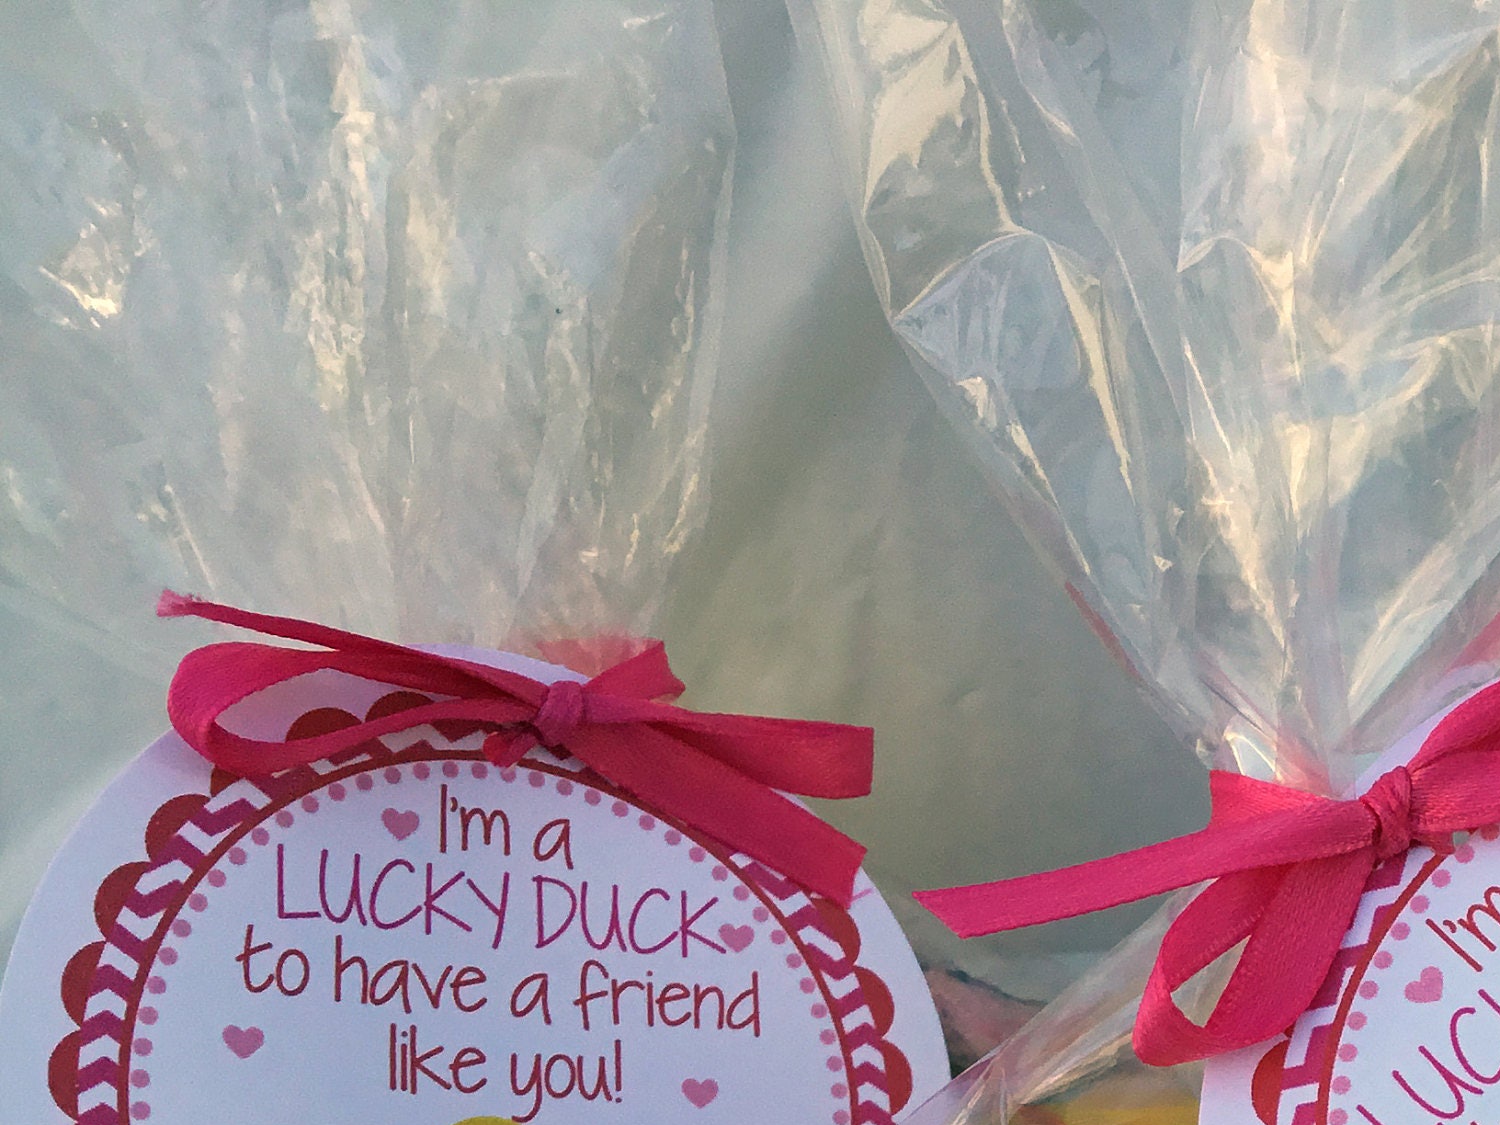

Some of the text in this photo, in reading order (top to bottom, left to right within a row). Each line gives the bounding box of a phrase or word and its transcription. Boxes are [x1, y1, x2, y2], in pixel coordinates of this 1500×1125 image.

[439, 783, 573, 870] I'm a
[276, 843, 728, 958] LUCKY DUCK
[236, 923, 761, 1038] to have a friend
[388, 1022, 623, 1122] like you!
